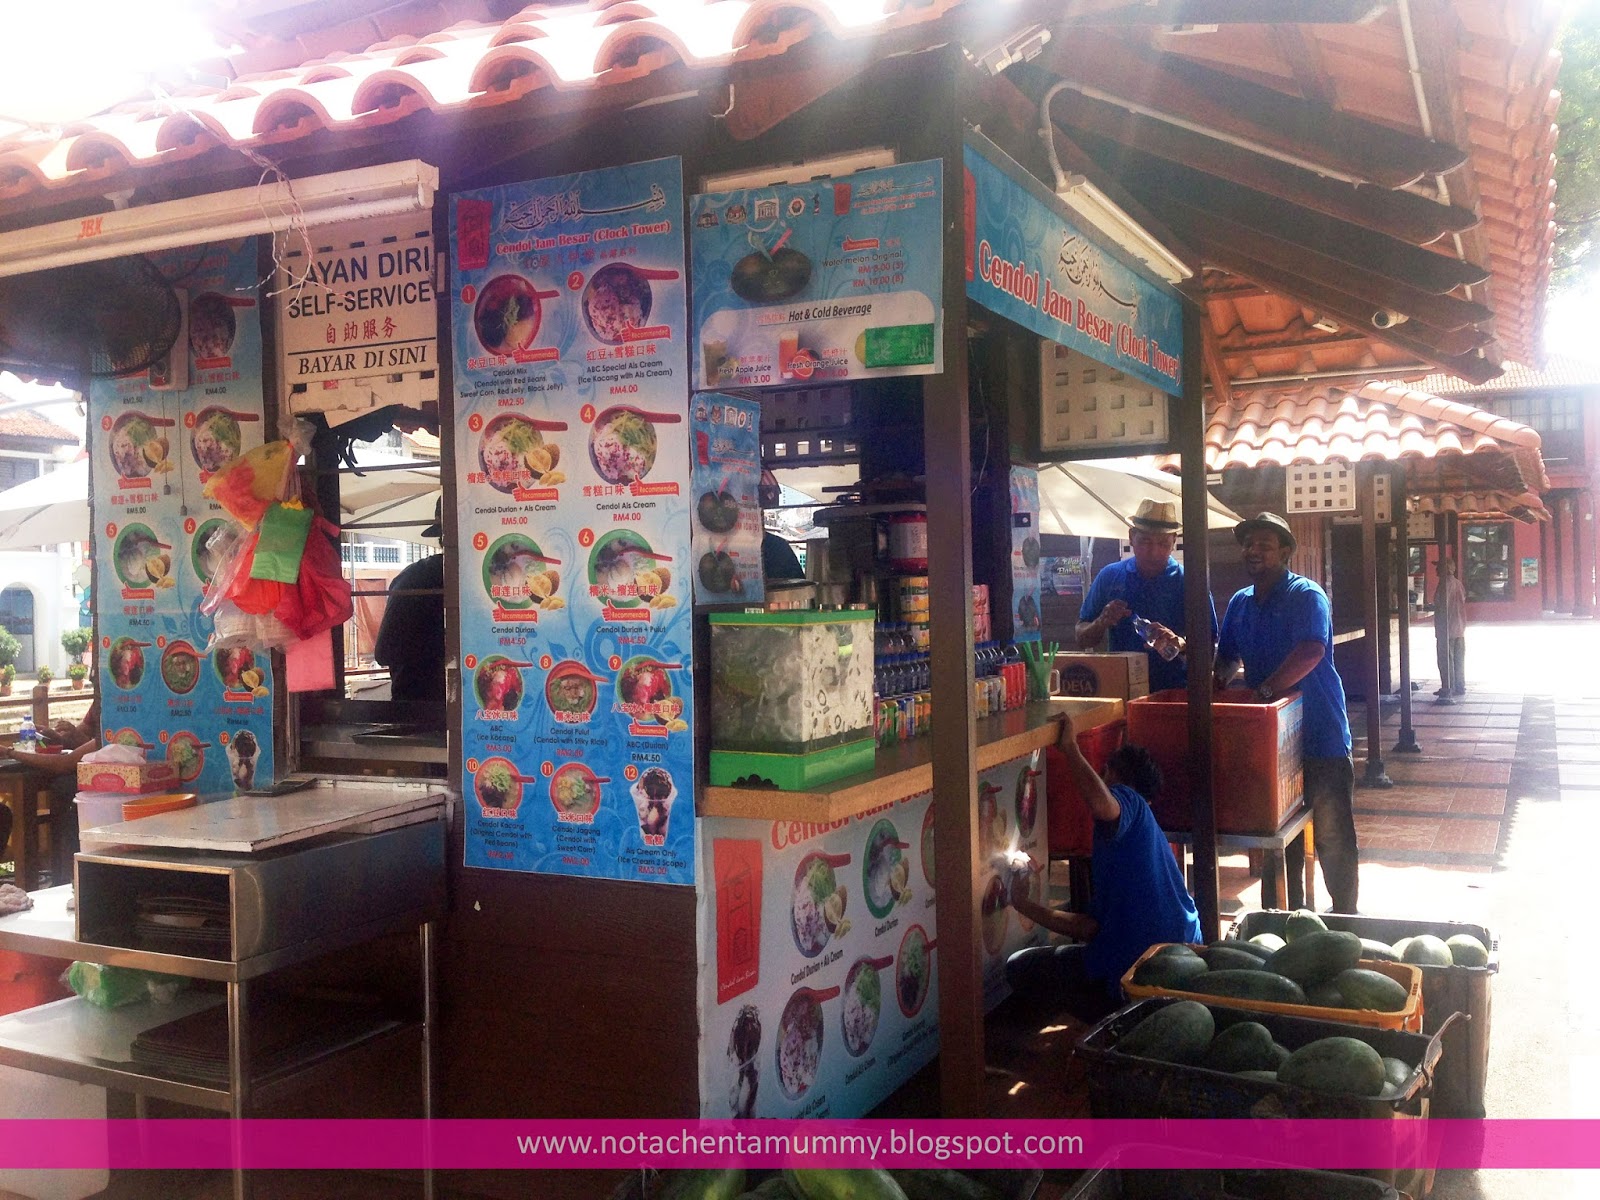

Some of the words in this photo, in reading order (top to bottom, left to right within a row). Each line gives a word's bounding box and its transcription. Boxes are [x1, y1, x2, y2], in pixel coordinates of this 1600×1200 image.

[496, 240, 532, 255] Cendol
[534, 237, 555, 251] Jam
[558, 233, 590, 246] Besar
[593, 227, 629, 242] (Clock
[631, 220, 671, 235] Tower)
[287, 255, 367, 290] LAYAN
[378, 246, 430, 278] DIRI
[288, 280, 430, 318] SELF-SERVICE
[788, 310, 804, 322] Hot
[804, 308, 811, 319] &
[812, 305, 831, 319] Cold
[833, 304, 872, 317] Beverage
[978, 239, 1039, 307] Cendol
[1042, 278, 1073, 326] Jam
[1077, 297, 1114, 346] Besar
[1116, 321, 1149, 365] (Clock
[1152, 339, 1181, 386] Tower)
[326, 316, 397, 344] 自助服务
[298, 353, 356, 375] BAYAR
[364, 350, 384, 369] DI
[388, 345, 427, 368] SINI
[609, 384, 638, 395] RM4.00
[474, 506, 497, 514] Cendol
[498, 505, 518, 513] Durian
[596, 503, 621, 511] Cendol
[632, 501, 656, 509] Cream
[501, 516, 528, 526] RM5.00
[613, 512, 642, 522] RM4.00
[491, 626, 514, 634] Cendol
[631, 753, 661, 762] RM4.50
